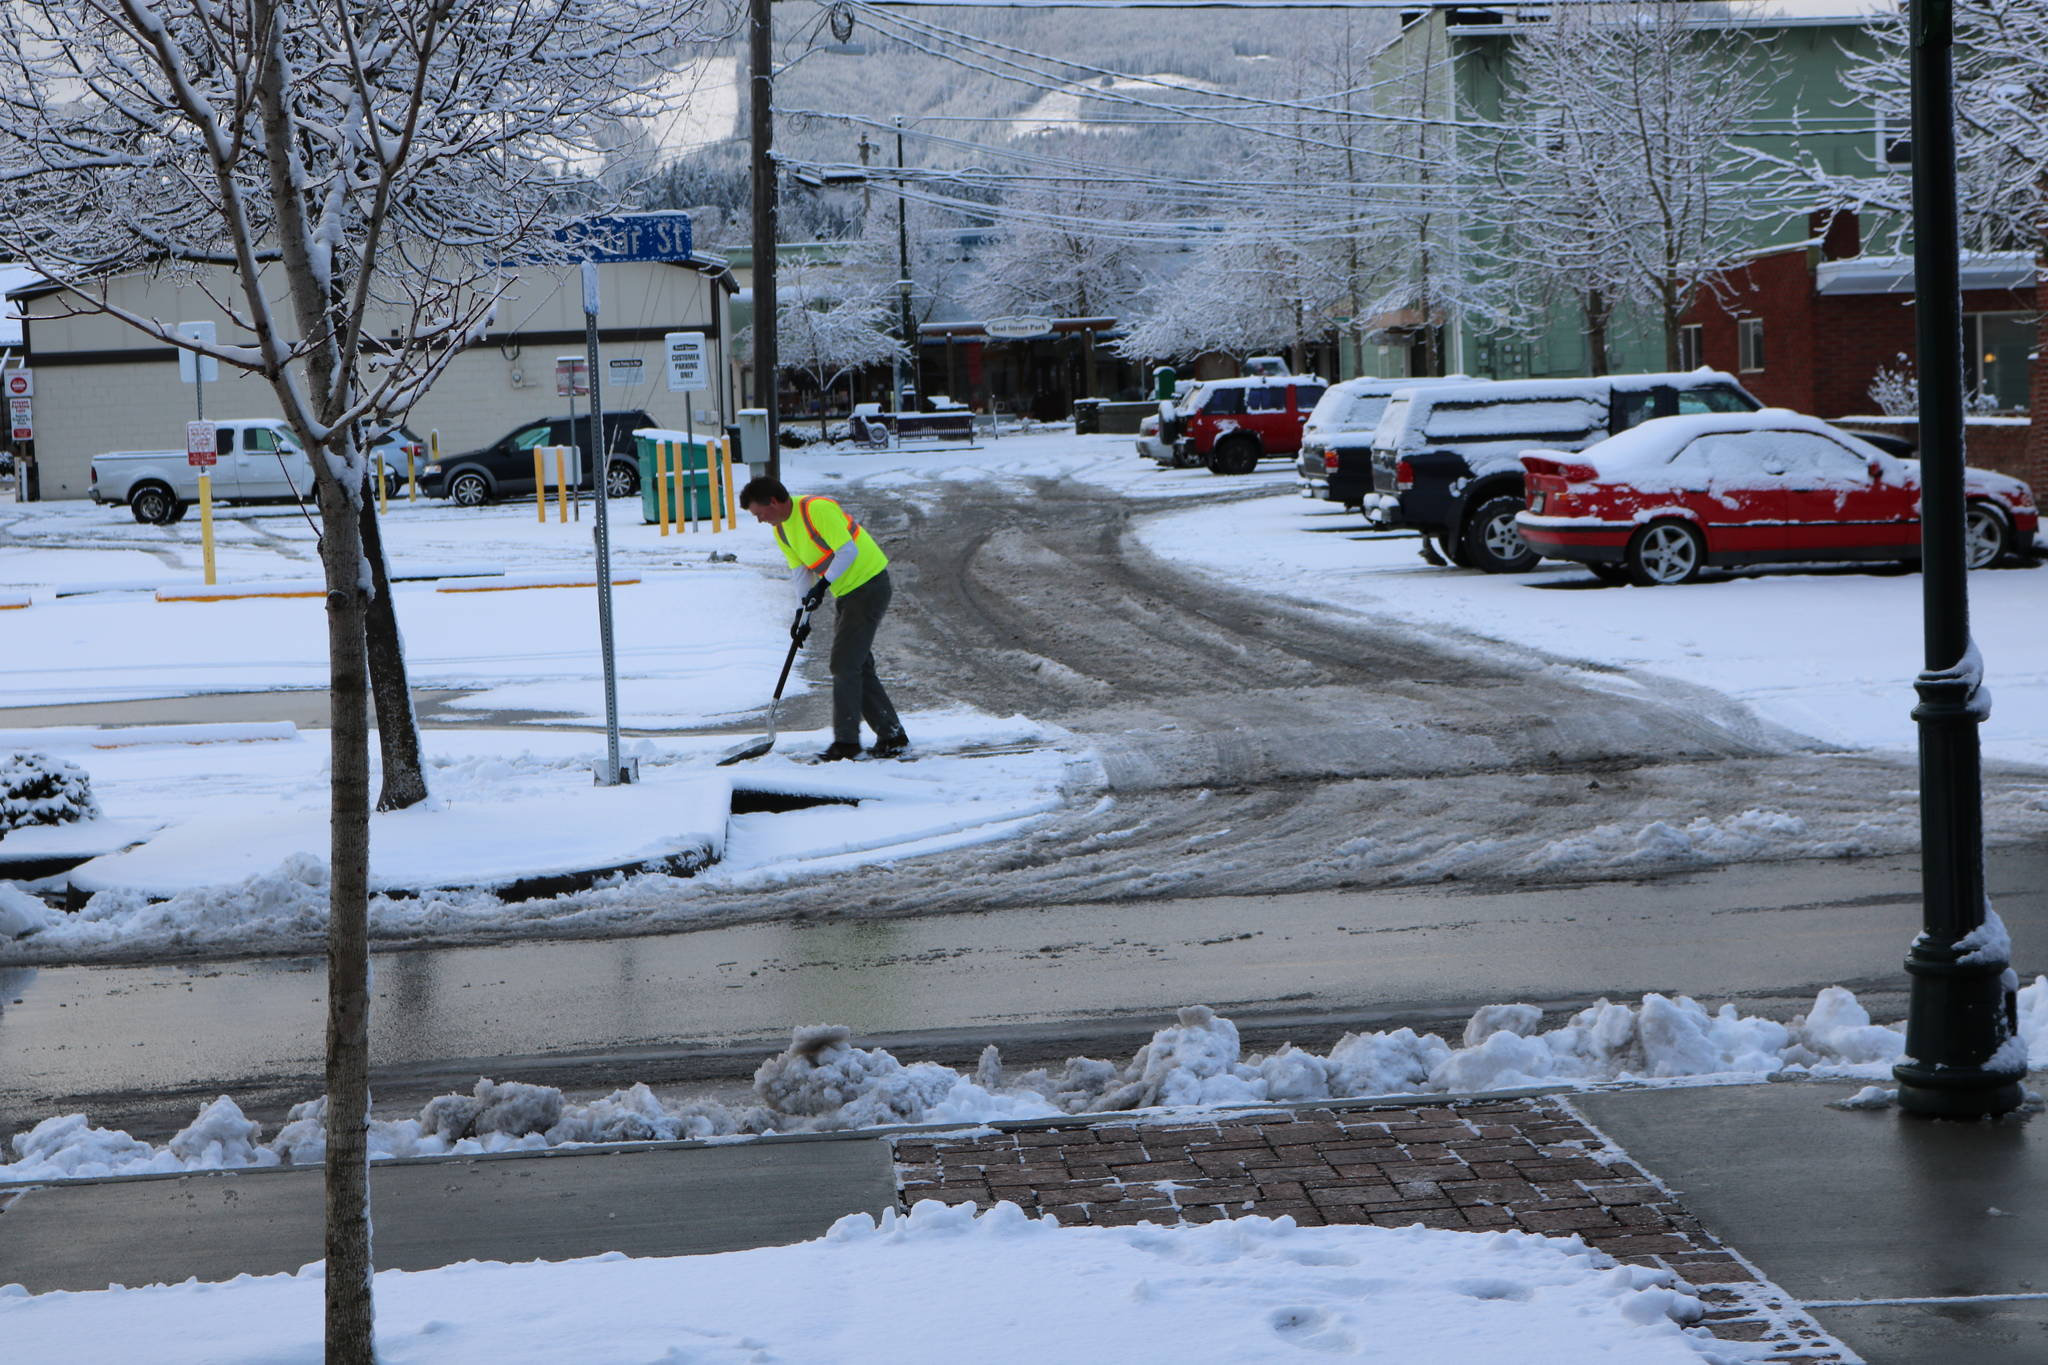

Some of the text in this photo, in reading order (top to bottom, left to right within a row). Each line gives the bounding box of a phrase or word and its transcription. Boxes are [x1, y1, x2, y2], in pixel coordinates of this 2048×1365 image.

[656, 222, 685, 255] St
[672, 353, 700, 361] CUSTOMER
[675, 362, 698, 370] PARKING
[680, 371, 693, 379] ONLY
